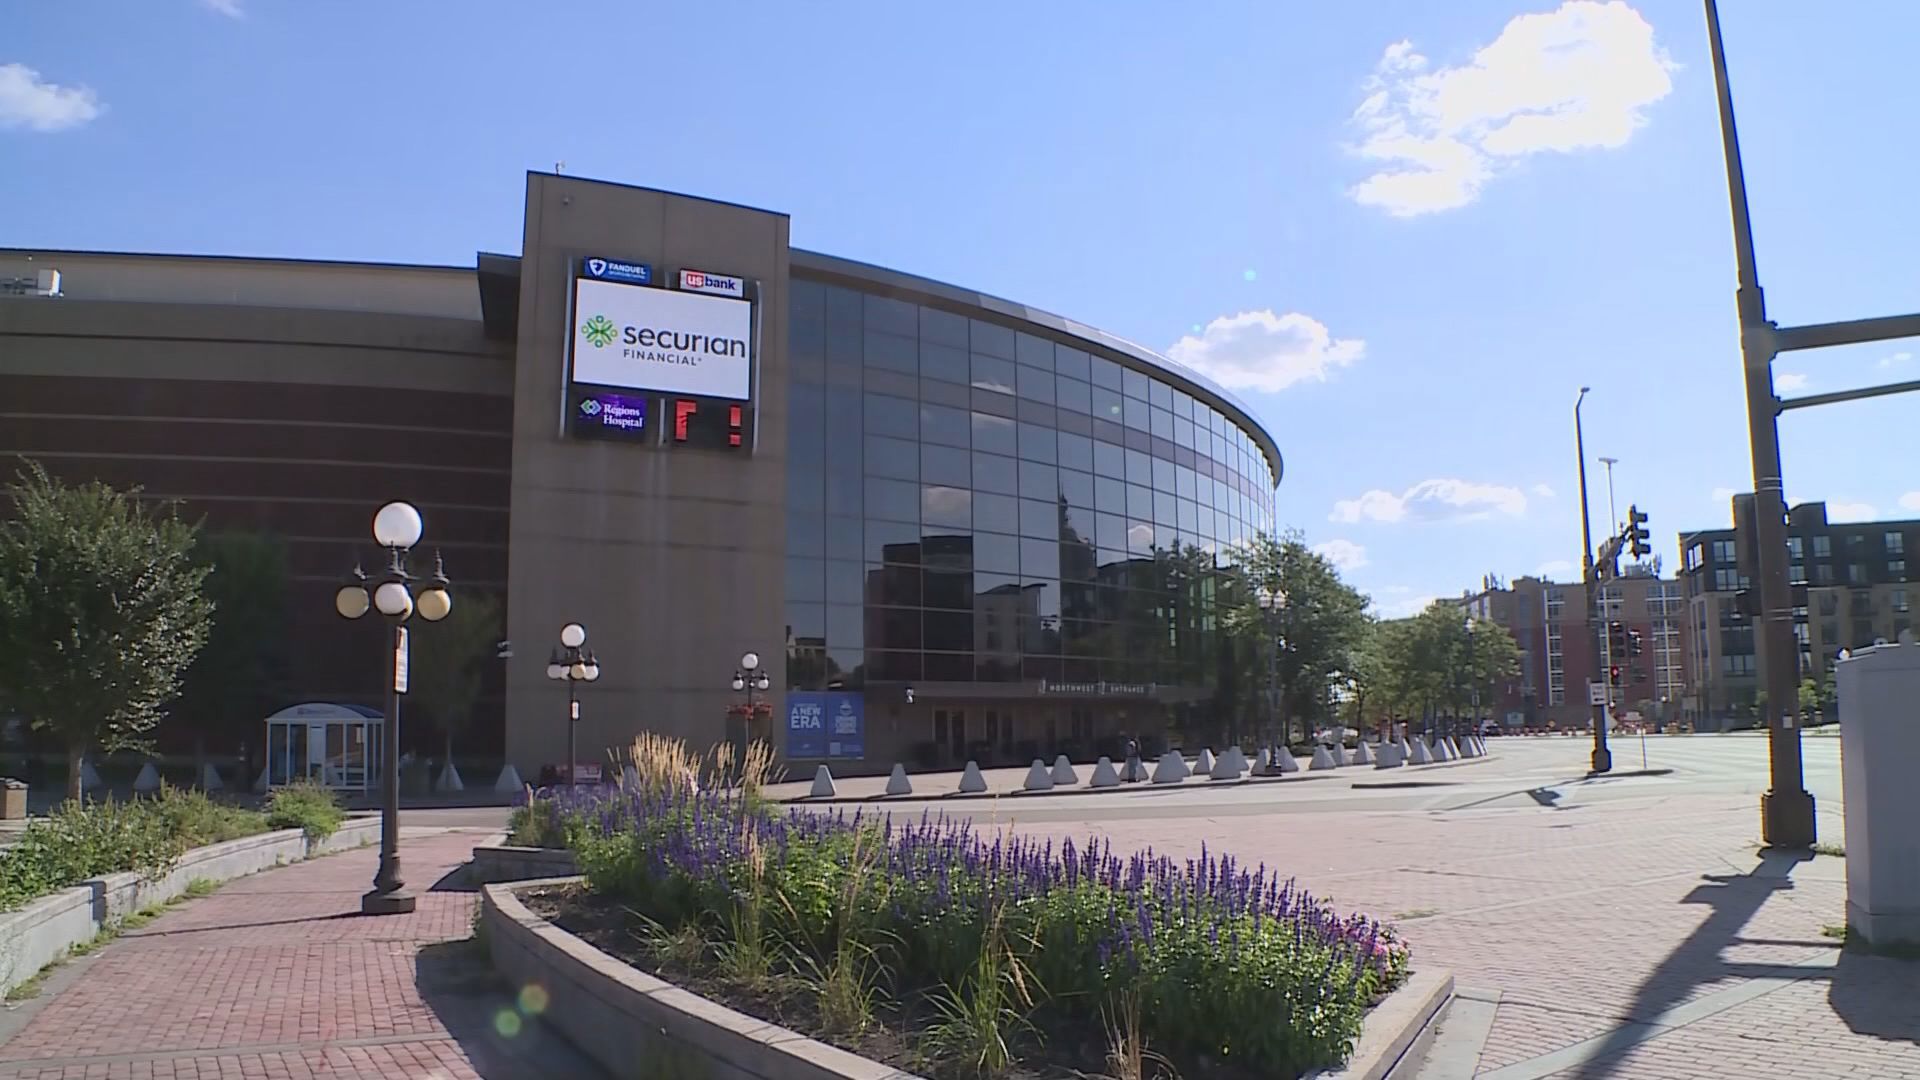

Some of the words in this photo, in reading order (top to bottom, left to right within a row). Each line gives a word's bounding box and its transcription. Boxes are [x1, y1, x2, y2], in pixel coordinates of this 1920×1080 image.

[608, 262, 646, 275] FANDUEL
[623, 326, 746, 358] securian
[603, 404, 640, 417] Regions
[603, 414, 643, 428] Hospital
[791, 707, 800, 716] A
[800, 707, 821, 716] NEW
[791, 716, 820, 729] ERA
